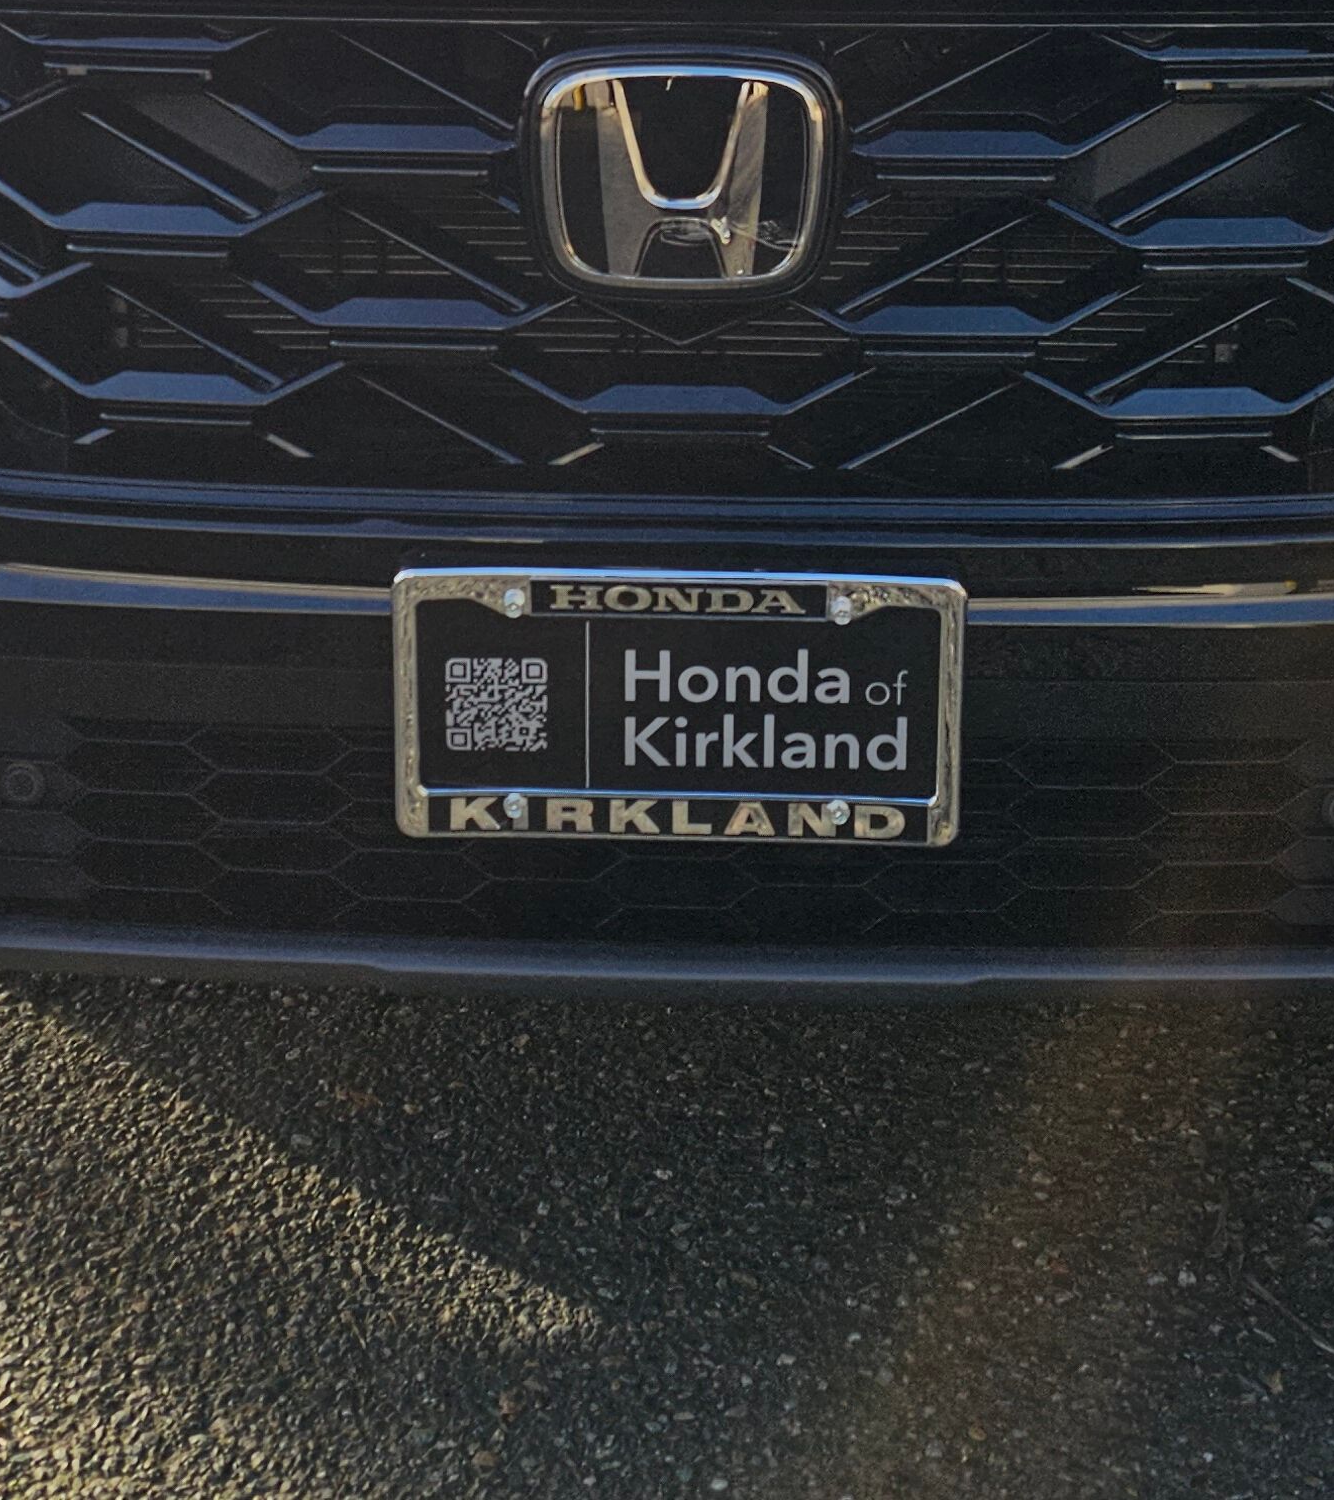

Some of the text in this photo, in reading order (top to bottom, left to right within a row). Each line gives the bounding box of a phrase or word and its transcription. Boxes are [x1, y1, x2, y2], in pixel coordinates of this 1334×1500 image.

[549, 584, 806, 615] HONDA
[623, 649, 908, 706] Honda of
[623, 714, 908, 771] Kirkland
[449, 797, 906, 838] KIRKLAND
